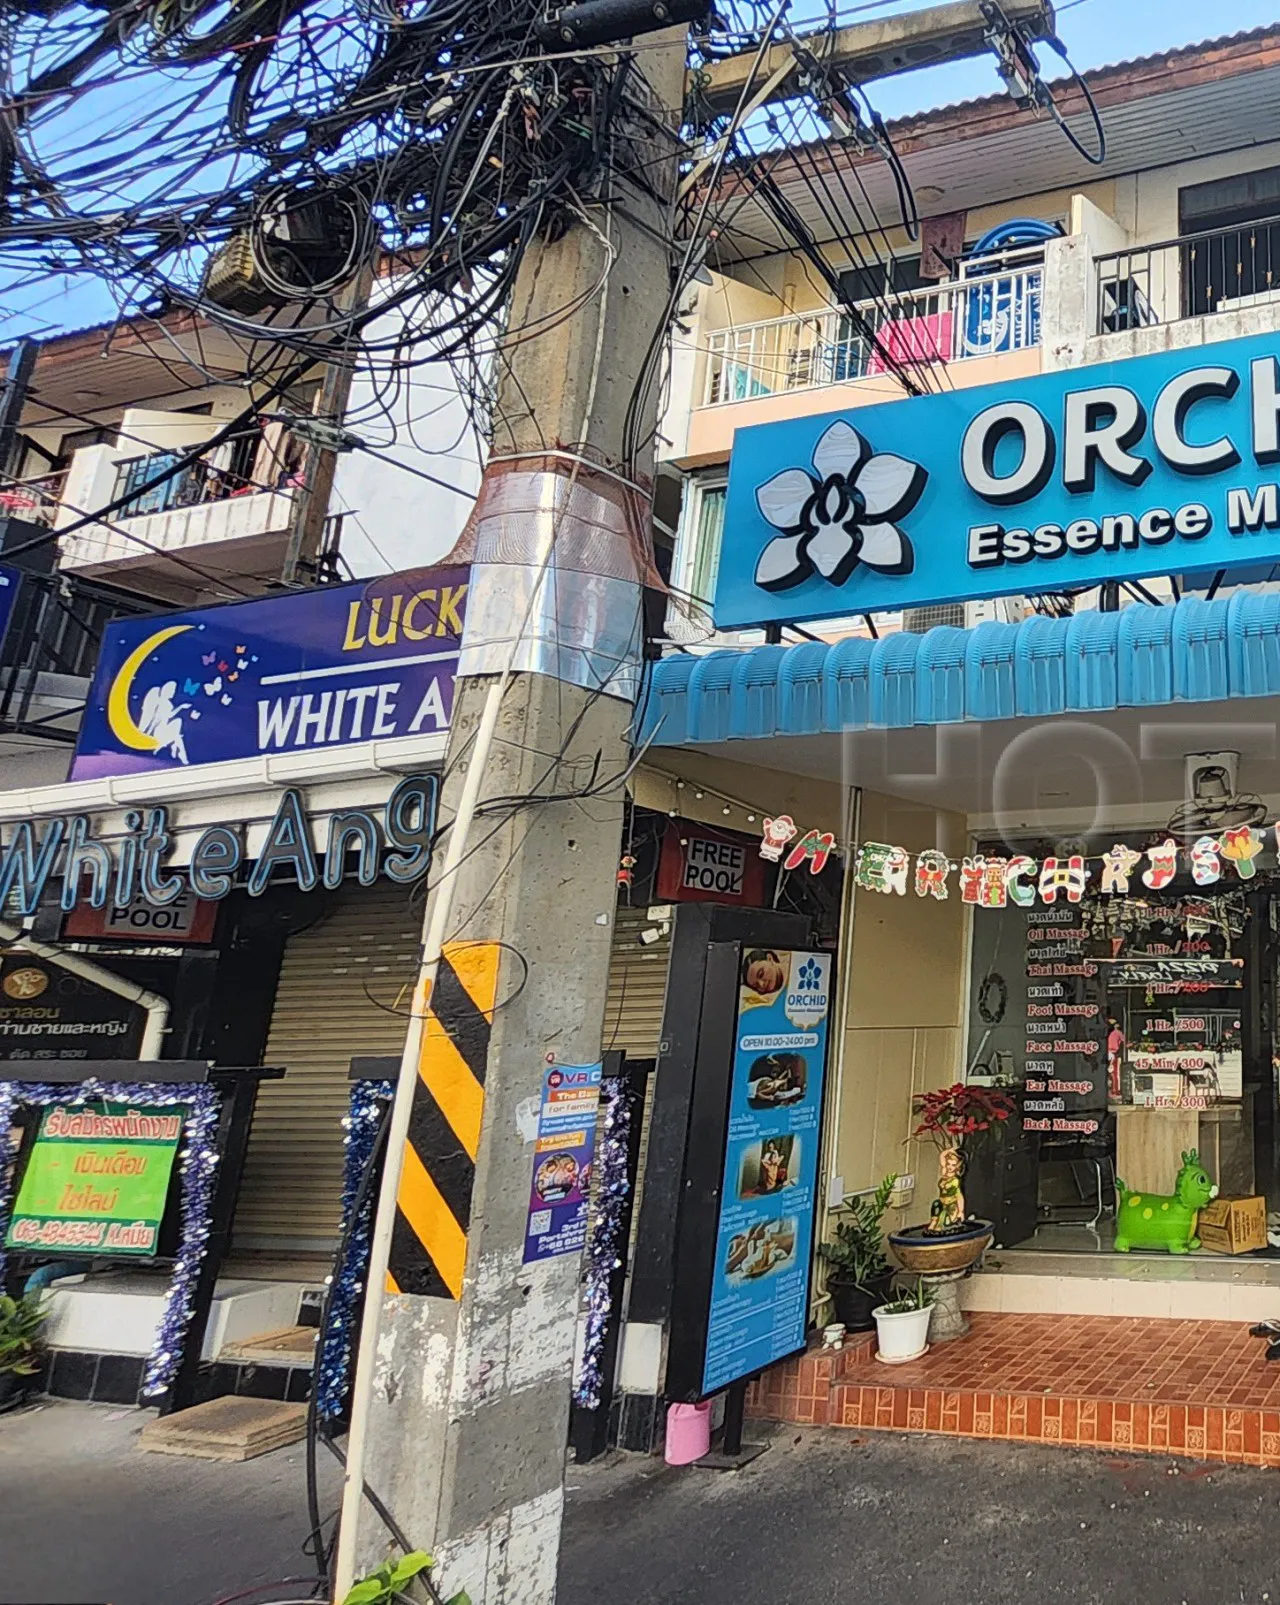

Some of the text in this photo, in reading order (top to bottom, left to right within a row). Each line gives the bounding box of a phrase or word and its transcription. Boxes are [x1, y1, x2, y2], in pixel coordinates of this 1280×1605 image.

[966, 498, 1212, 568] Essence
[257, 681, 401, 750] WHITE
[407, 675, 457, 733] A
[691, 839, 742, 869] FREE
[685, 865, 742, 894] POOL
[109, 907, 188, 930] POOL
[1028, 928, 1090, 941] Oil Massage
[1028, 963, 1098, 977] Thai Massage
[787, 994, 827, 1006] ORCHID
[1027, 1004, 1099, 1018] Foot Massage
[743, 1038, 763, 1048] OPEN
[1026, 1041, 1099, 1055] Face Massage
[1134, 1058, 1149, 1069] 45
[1181, 1058, 1205, 1069] 300
[563, 1072, 588, 1083] VR
[1026, 1080, 1093, 1095] Ear Massage
[1181, 1097, 1206, 1108] 300
[1023, 1118, 1099, 1134] Back Massage
